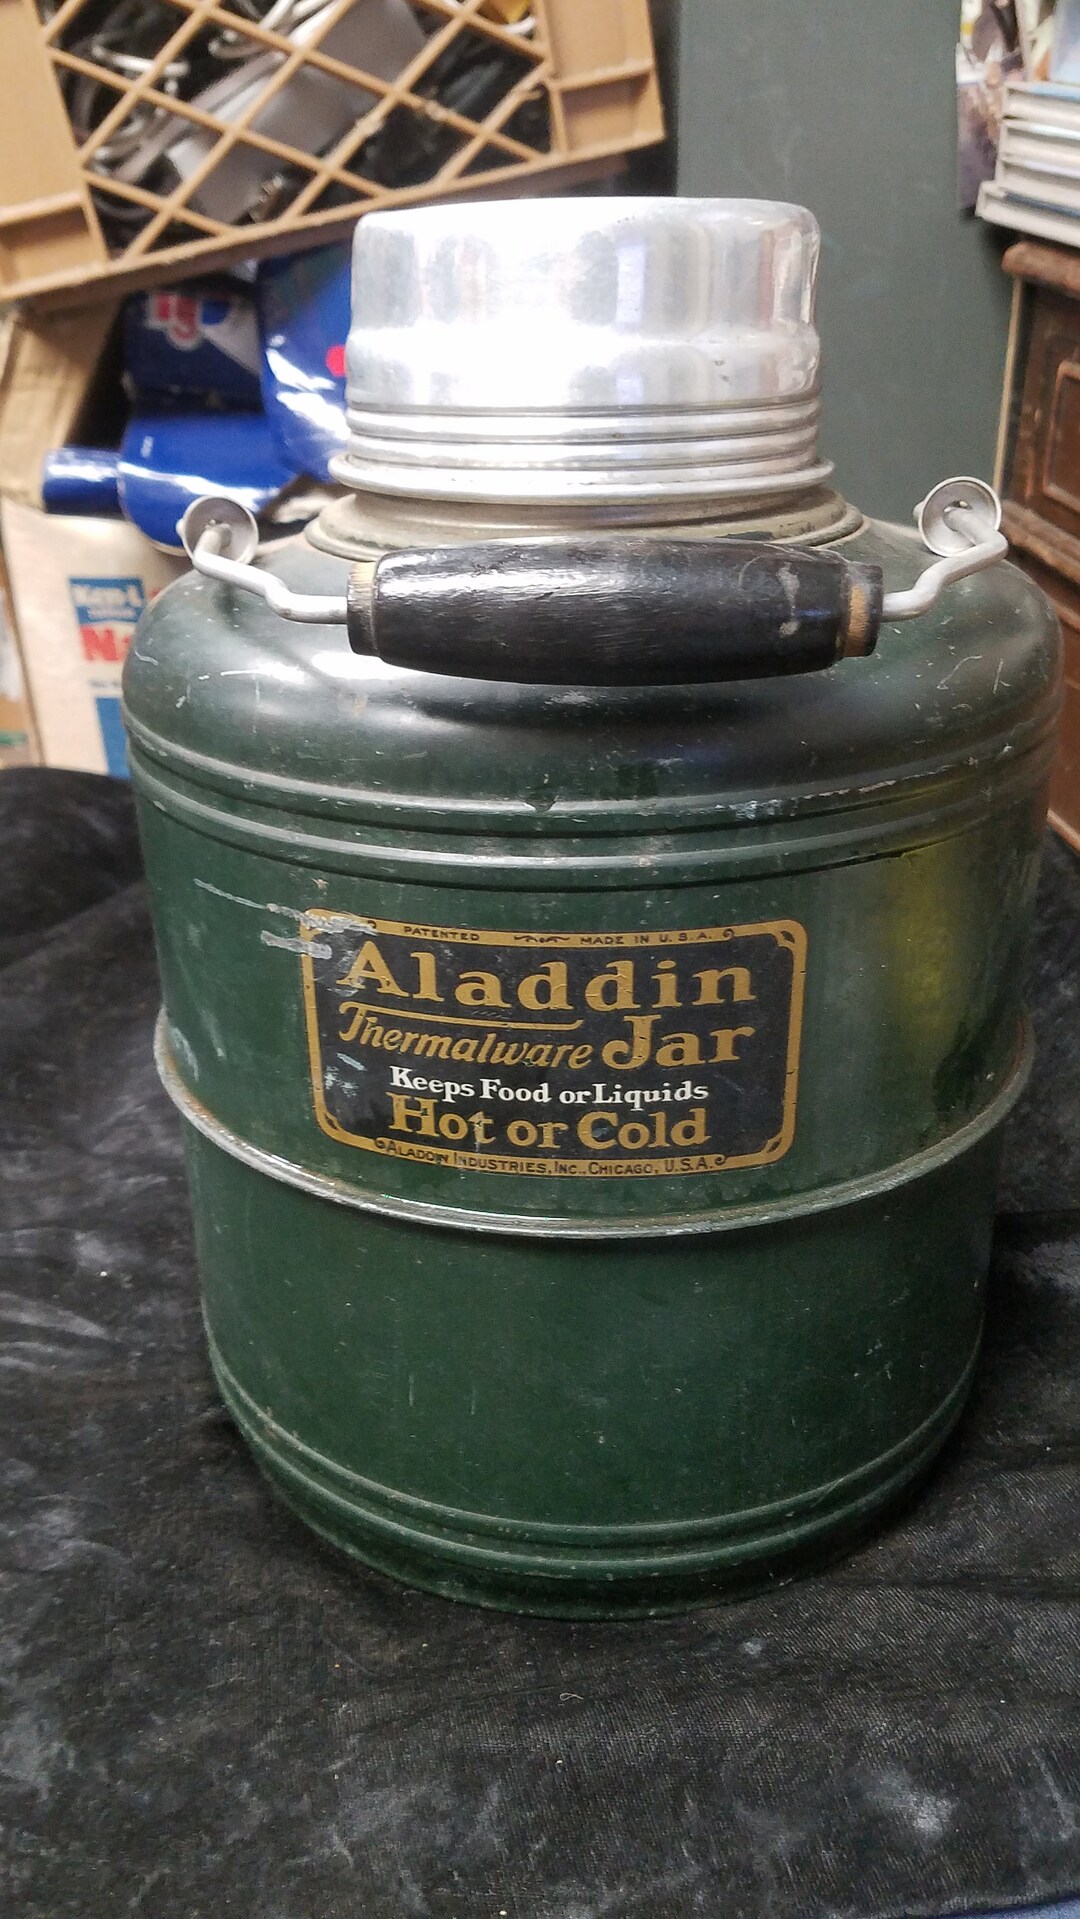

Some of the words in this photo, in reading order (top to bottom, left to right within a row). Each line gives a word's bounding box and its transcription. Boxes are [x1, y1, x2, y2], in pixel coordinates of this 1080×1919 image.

[403, 926, 480, 942] PATENTED
[579, 936, 624, 945] MADE
[634, 934, 650, 944] IN
[335, 941, 757, 1012] Aladdin
[336, 1000, 592, 1070] Thermalware
[601, 1015, 756, 1071] Jar
[389, 1065, 475, 1103] Keeps
[479, 1078, 552, 1103] Food
[558, 1089, 592, 1104] or
[592, 1080, 709, 1111] Liquids
[385, 1091, 497, 1145] Hot
[506, 1119, 569, 1149] or
[576, 1107, 712, 1150] Cold
